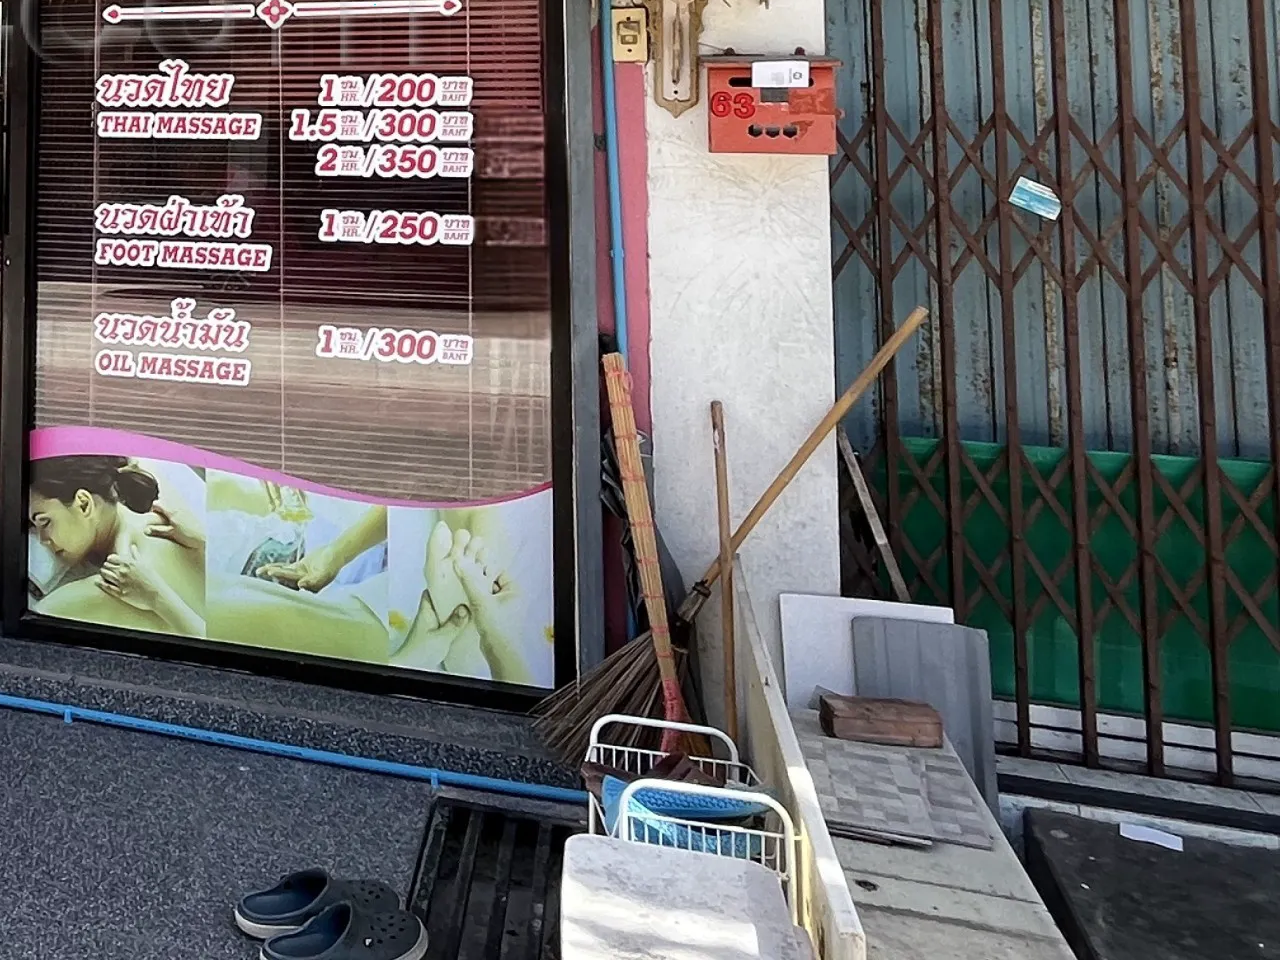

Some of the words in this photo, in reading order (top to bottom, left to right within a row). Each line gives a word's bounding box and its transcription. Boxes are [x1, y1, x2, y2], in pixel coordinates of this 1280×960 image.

[99, 62, 232, 104] นวดไทย
[322, 78, 335, 102] 1
[711, 91, 756, 119] 63
[100, 115, 151, 134] THAI
[155, 115, 259, 137] MASSAGE
[293, 113, 337, 137] 1.5
[319, 147, 338, 172] 2
[98, 197, 252, 235] นวดฝ่าเท้า
[323, 213, 335, 237] 1
[98, 242, 156, 262] FOOT
[160, 244, 269, 268] MASSAGE
[97, 301, 247, 349] นวดน้ำมัน
[321, 329, 333, 353] 1
[97, 352, 133, 373] OIL
[138, 355, 248, 383] MASSAGE
